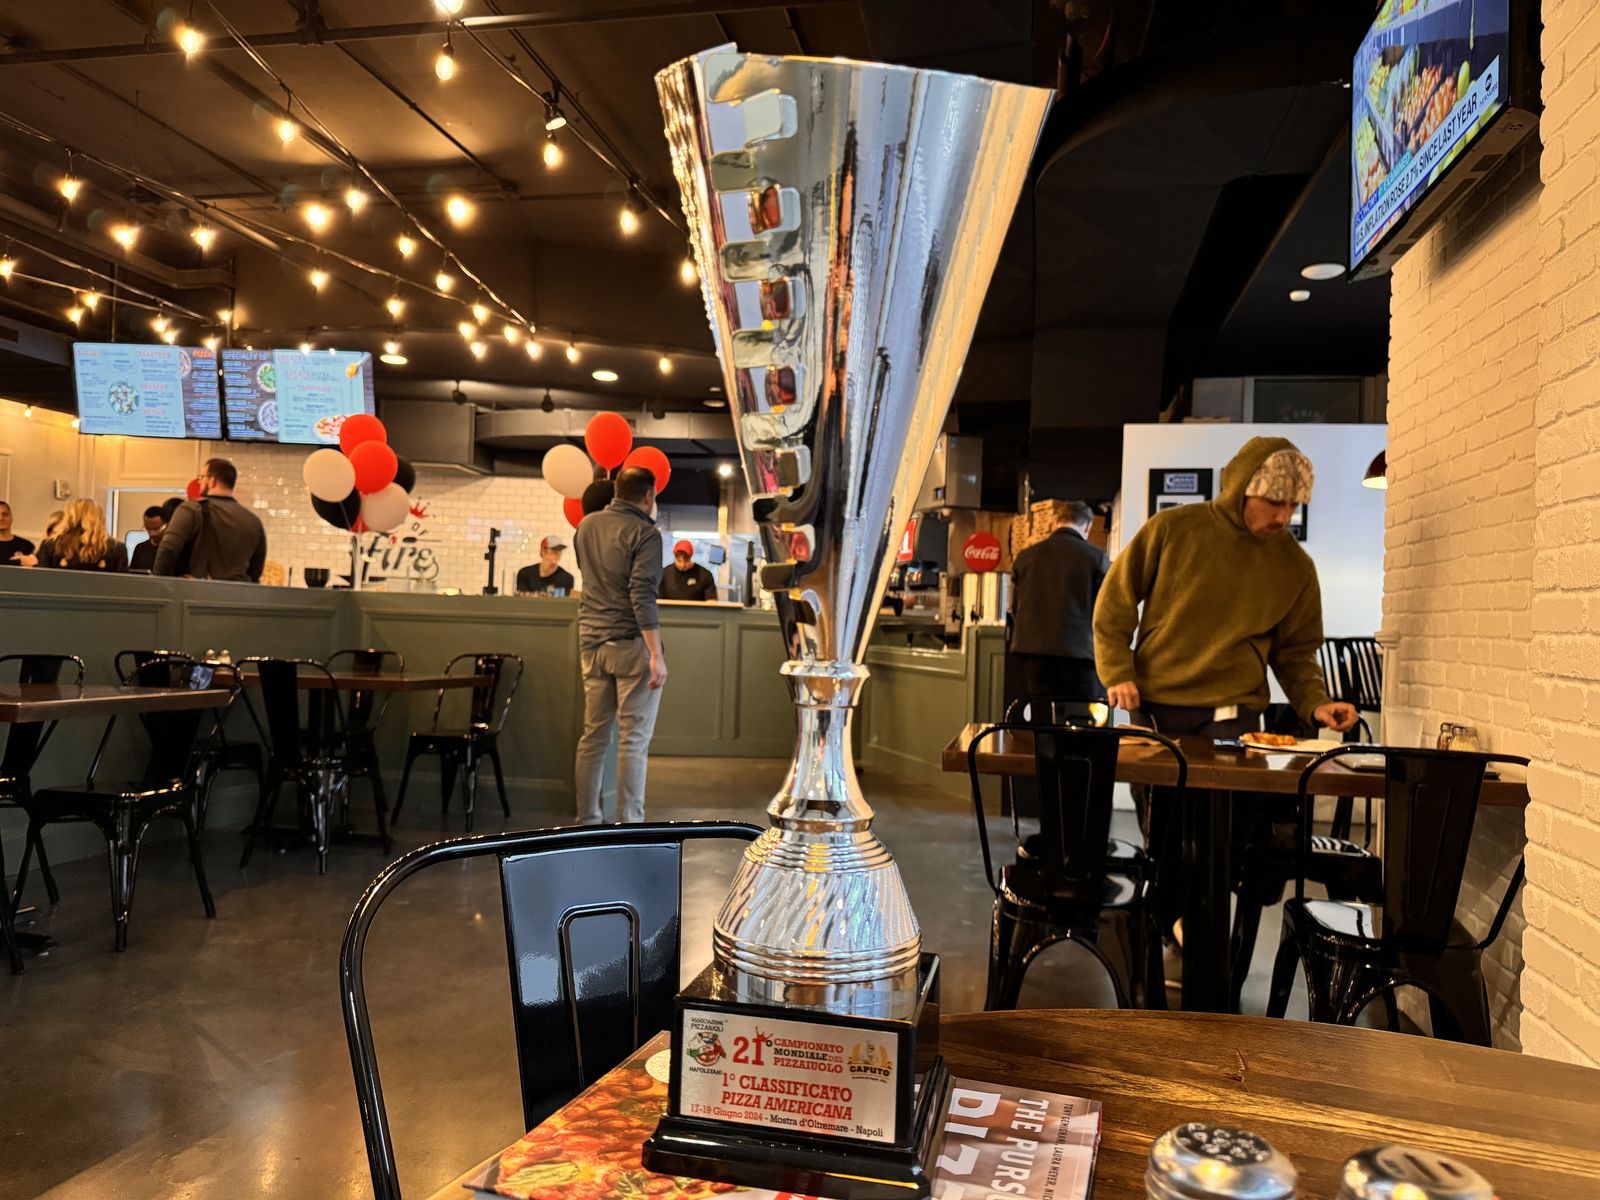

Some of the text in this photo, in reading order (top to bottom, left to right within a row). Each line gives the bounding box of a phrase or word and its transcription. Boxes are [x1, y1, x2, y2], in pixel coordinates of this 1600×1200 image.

[1364, 195, 1390, 234] INFLATION
[1390, 177, 1405, 205] ROSE
[1419, 138, 1438, 173] SINCE
[1438, 116, 1456, 151] LAST
[1456, 92, 1478, 129] YEAR
[774, 1038, 844, 1054] CAMPIONATO
[774, 1048, 844, 1063] MONDIALE DEL
[689, 1066, 722, 1075] NAPOLETANI
[773, 1056, 843, 1074] PIZZAIUOLO
[849, 1065, 890, 1077] CAPUTO
[739, 1074, 853, 1102] CLASSIFICATO
[721, 1091, 853, 1121] PIZZA AMERICANA
[1062, 1103, 1074, 1116] TONY
[713, 1106, 743, 1119] Giugno
[744, 1110, 763, 1122] 2024
[770, 1114, 798, 1126] Mostra
[799, 1118, 849, 1133] d'Oltremare
[855, 1125, 884, 1138] Napoli
[1010, 1098, 1050, 1133] THE
[1050, 1147, 1065, 1165] LAURA
[1045, 1165, 1060, 1187] MEYER,
